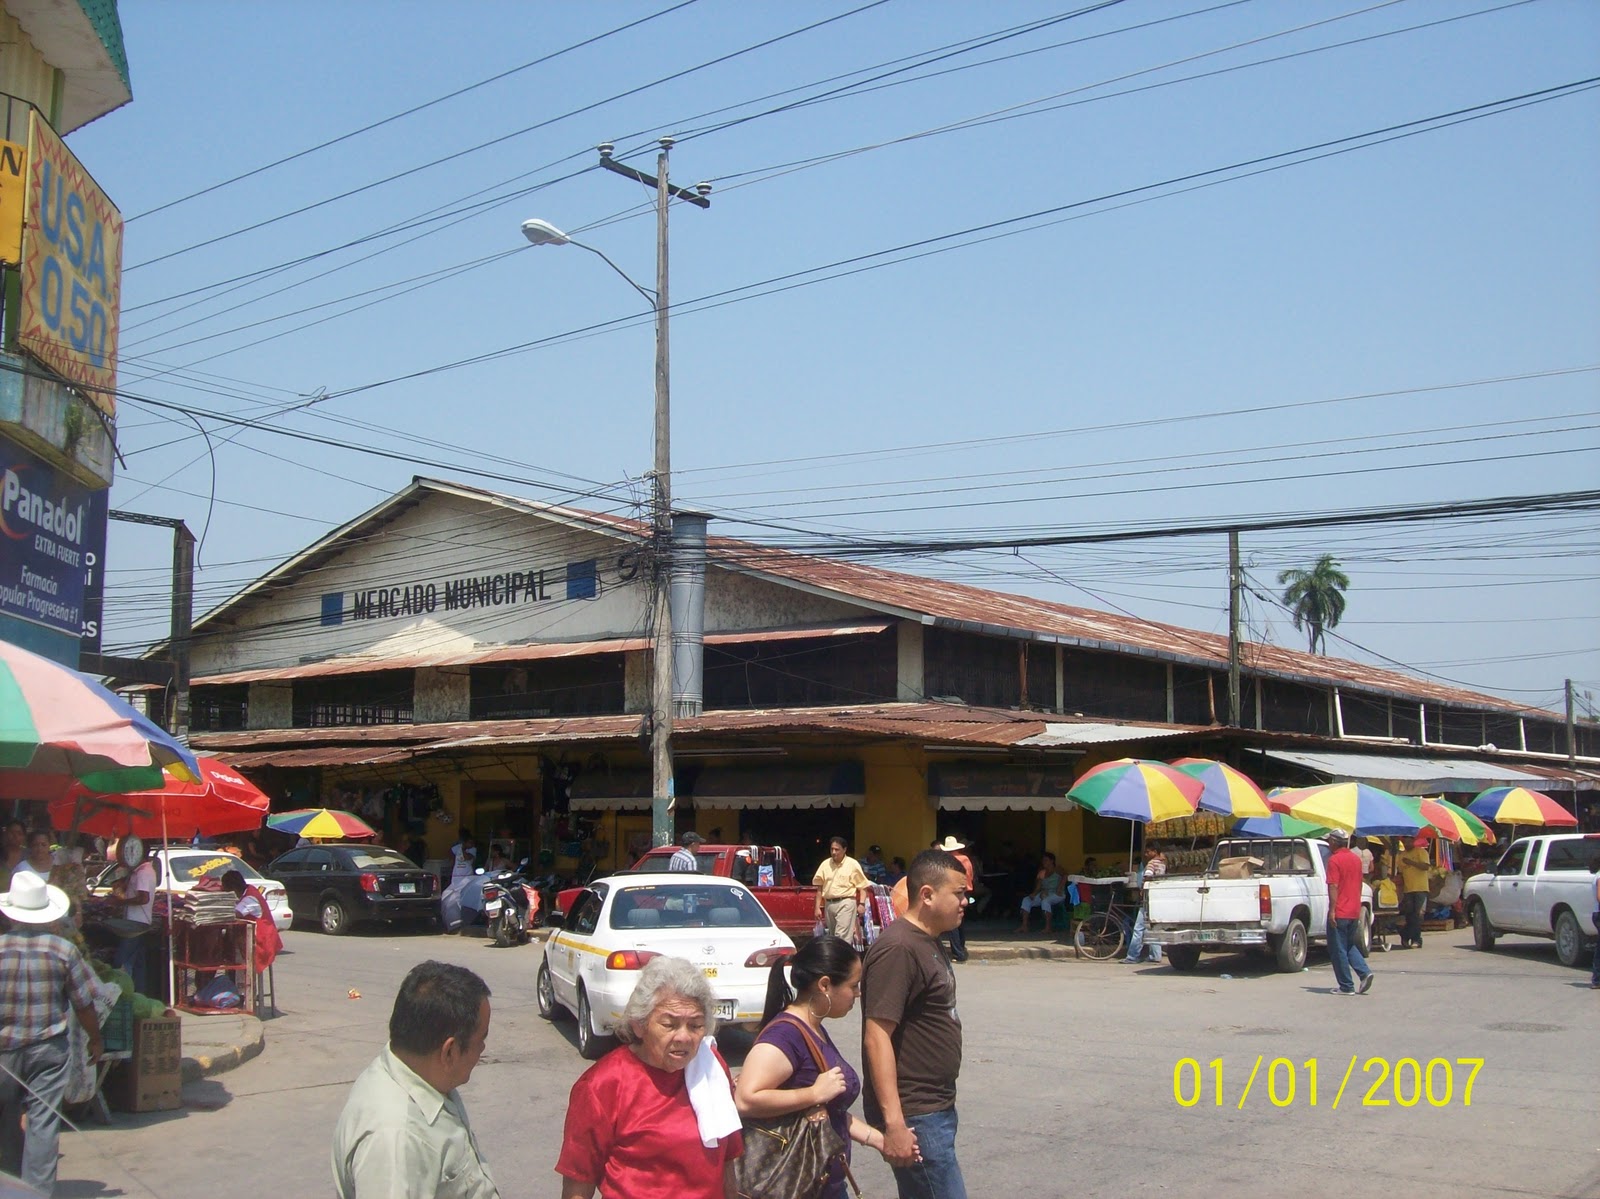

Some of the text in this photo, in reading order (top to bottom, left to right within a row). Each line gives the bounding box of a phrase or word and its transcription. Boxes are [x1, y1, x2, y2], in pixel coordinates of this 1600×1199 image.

[41, 255, 107, 369] 0.50
[4, 468, 83, 545] Panadol
[35, 535, 80, 568] EXTRA FUERTE
[21, 565, 58, 596] Farmacia
[353, 569, 552, 620] MERCADO MUNICIPAL
